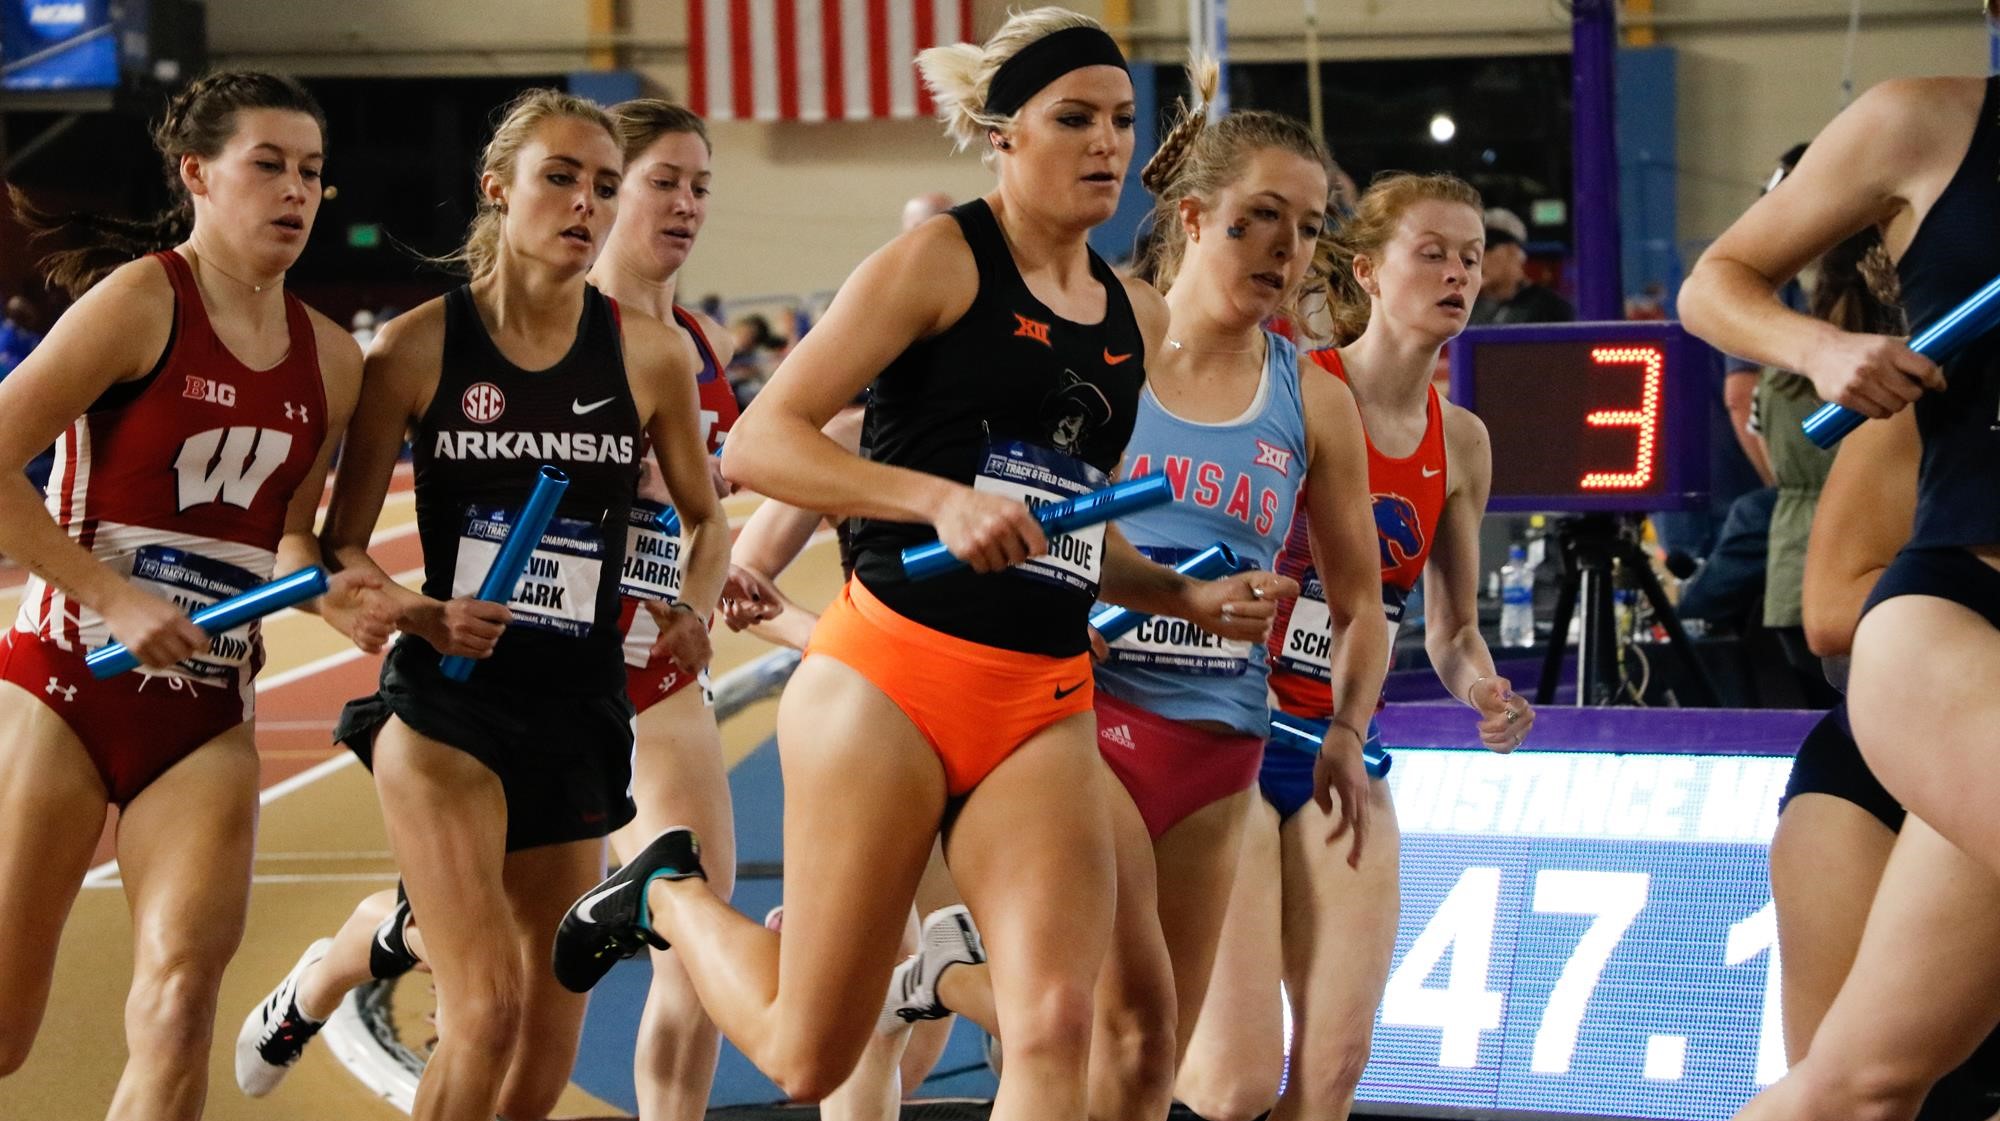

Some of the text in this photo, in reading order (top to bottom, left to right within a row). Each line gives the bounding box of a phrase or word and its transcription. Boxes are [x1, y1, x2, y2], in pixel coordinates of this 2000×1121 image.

[466, 385, 501, 421] SEC
[1580, 345, 1663, 490] 3
[434, 431, 634, 464] ARKANSAS
[1254, 439, 1292, 478] XII
[174, 426, 293, 512] W
[1006, 463, 1033, 478] TRACK
[487, 524, 510, 538] TRAC
[541, 534, 598, 552] CHAMPIONSHIPS
[636, 535, 680, 562] HALEY
[524, 556, 560, 579] VIN
[1290, 629, 1332, 659] SCH
[1101, 730, 1136, 750] adidas
[1400, 753, 1697, 838] DISTANCE
